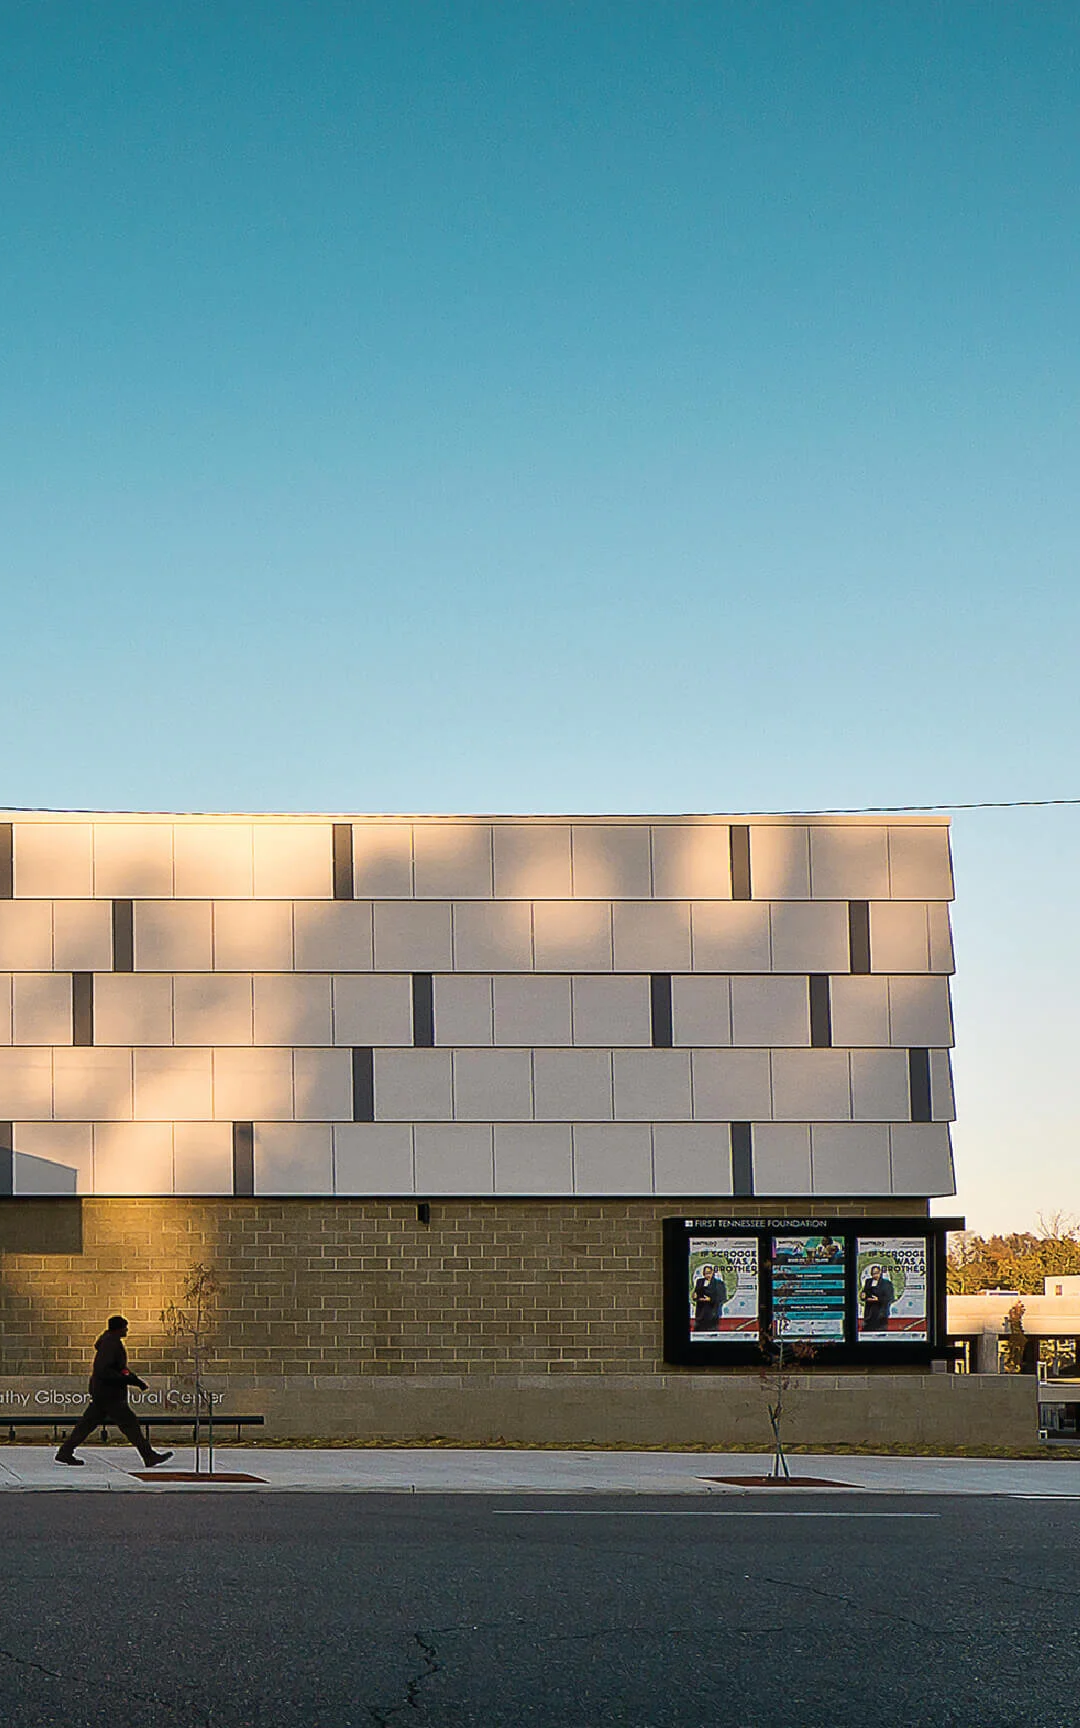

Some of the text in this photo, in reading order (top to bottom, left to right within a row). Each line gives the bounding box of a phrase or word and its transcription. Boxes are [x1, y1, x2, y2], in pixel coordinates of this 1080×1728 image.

[695, 1219, 827, 1228] FIRST TENNESSEE FOUNDATION
[711, 1250, 757, 1258] SCROOGE
[879, 1250, 925, 1258] SCROOGE
[727, 1257, 757, 1265] WAS A
[894, 1257, 925, 1265] WAS A
[166, 1389, 225, 1404] Center
